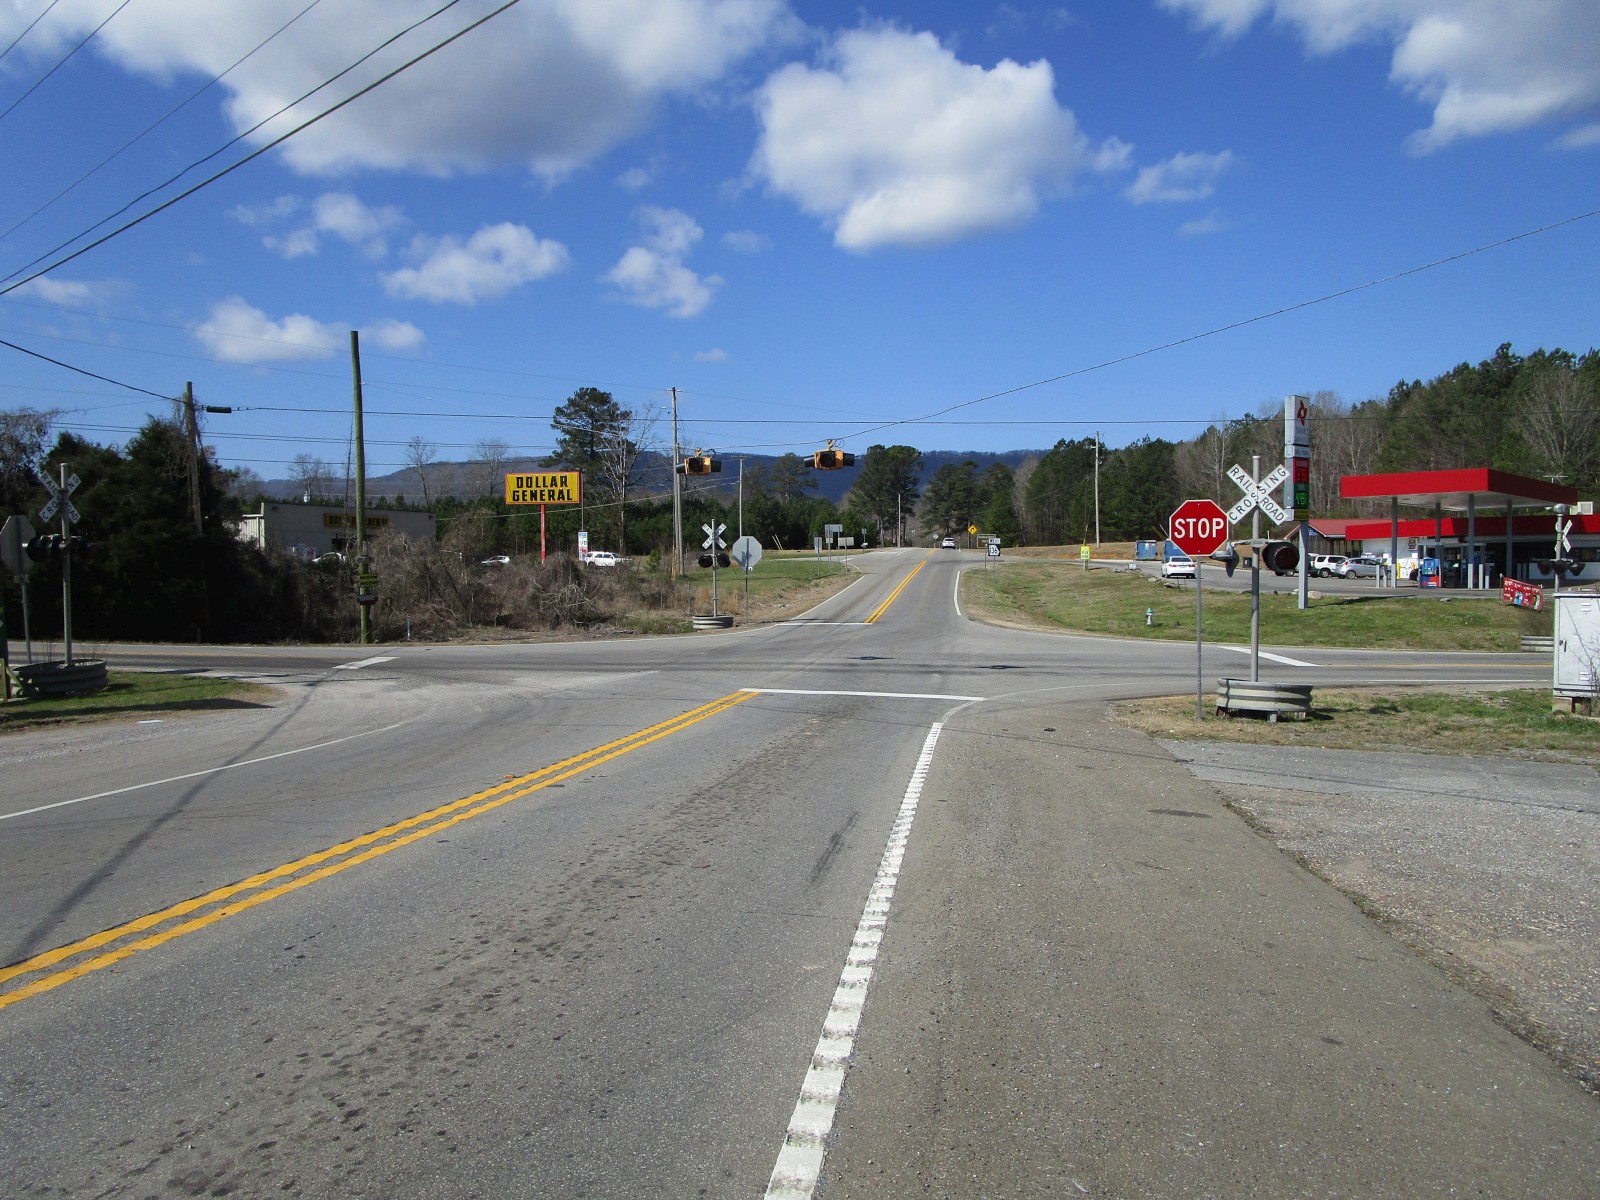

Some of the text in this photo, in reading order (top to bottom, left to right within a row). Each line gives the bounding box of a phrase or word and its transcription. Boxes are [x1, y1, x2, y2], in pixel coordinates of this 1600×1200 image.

[516, 475, 568, 488] DOLLAR
[513, 489, 573, 501] GENERAL
[1229, 468, 1287, 521] CROSSING
[1230, 467, 1253, 492] RAIL
[1260, 497, 1285, 521] ROAD
[1174, 518, 1224, 538] STOP
